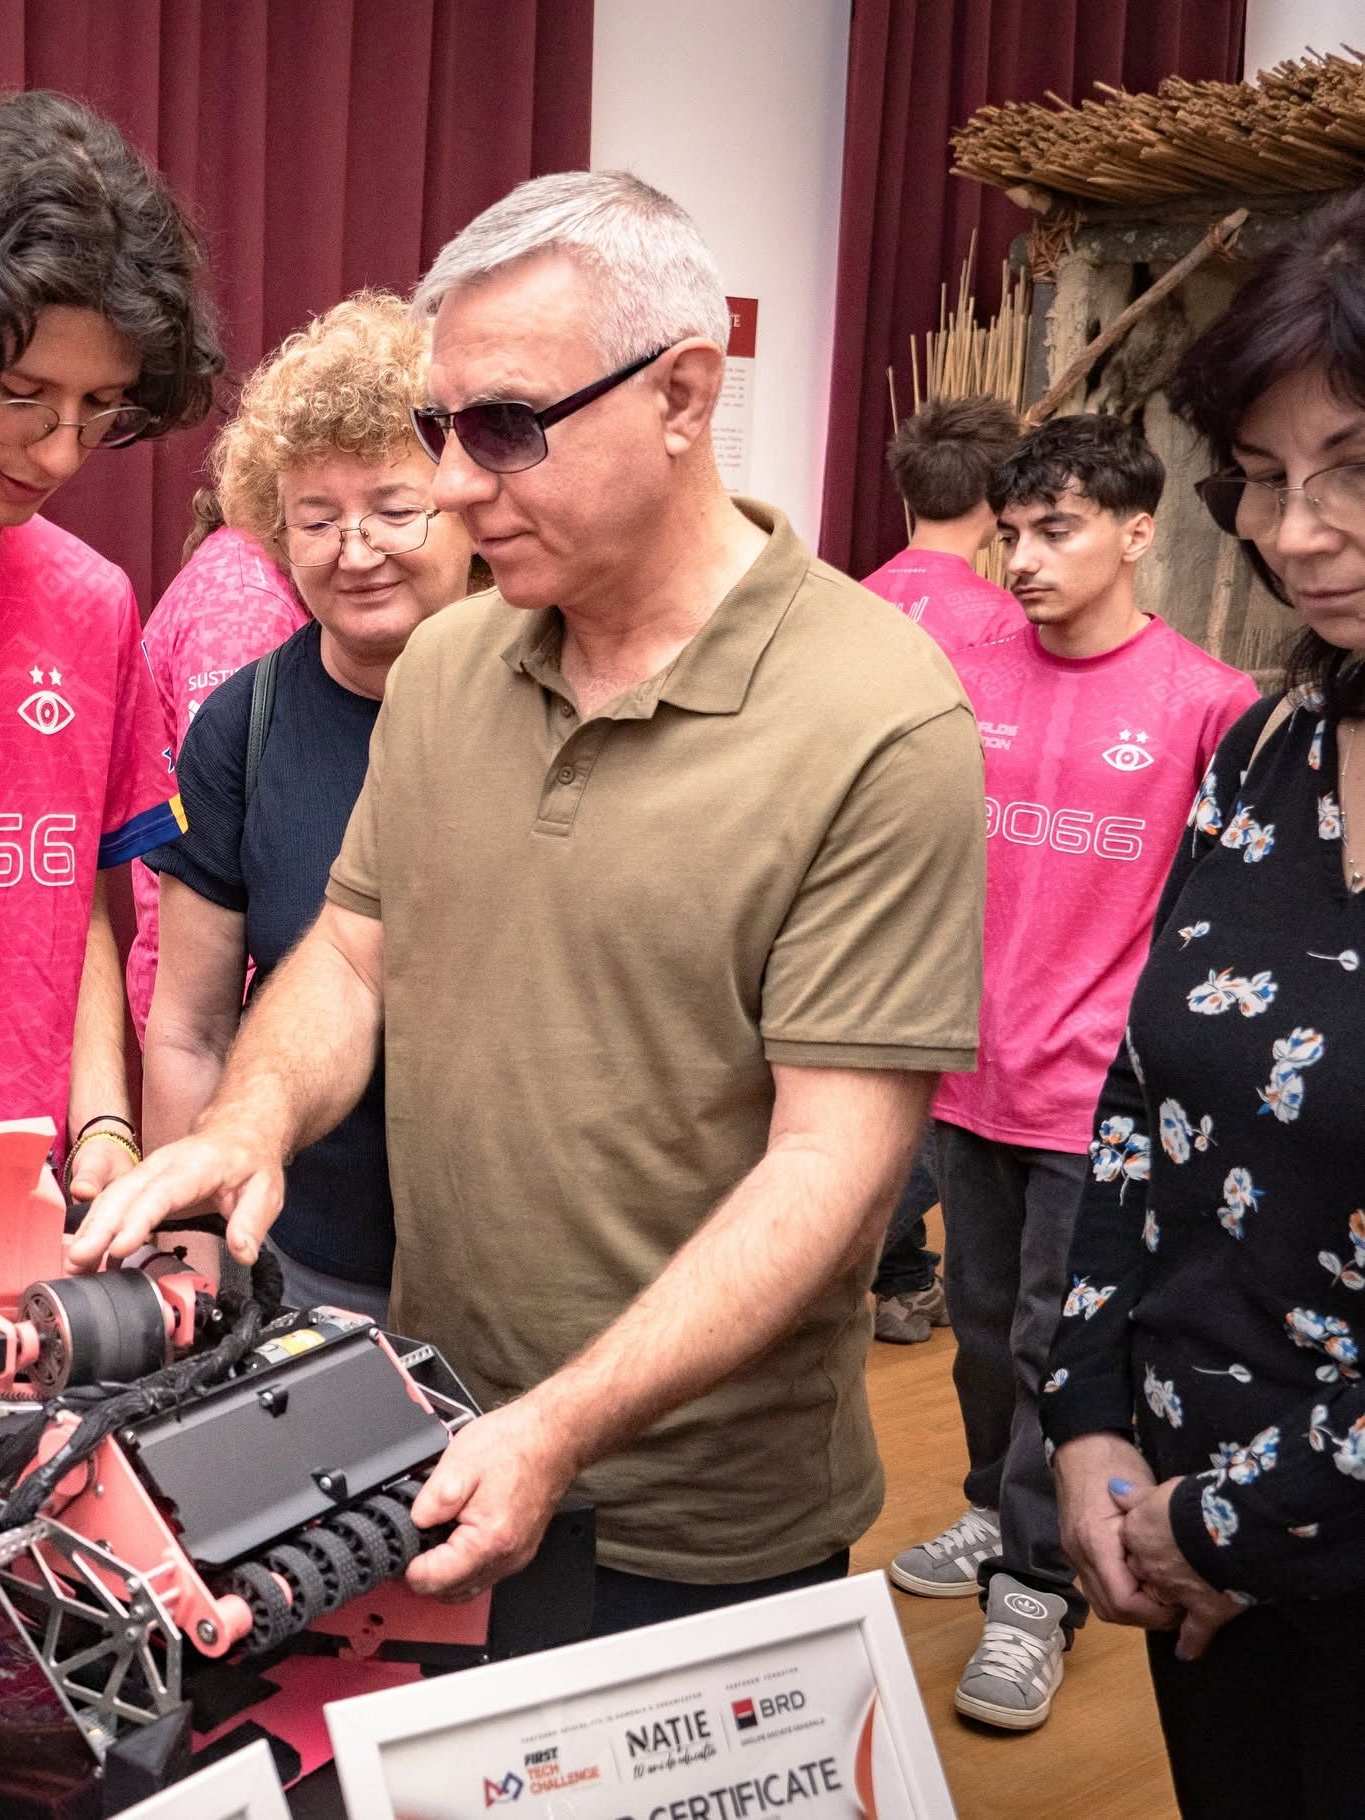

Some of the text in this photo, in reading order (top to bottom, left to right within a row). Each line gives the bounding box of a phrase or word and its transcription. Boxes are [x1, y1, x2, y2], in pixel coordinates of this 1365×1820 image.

[759, 1690, 805, 1718] BRD
[524, 1746, 558, 1766] FIRST
[528, 1764, 559, 1780] TECH
